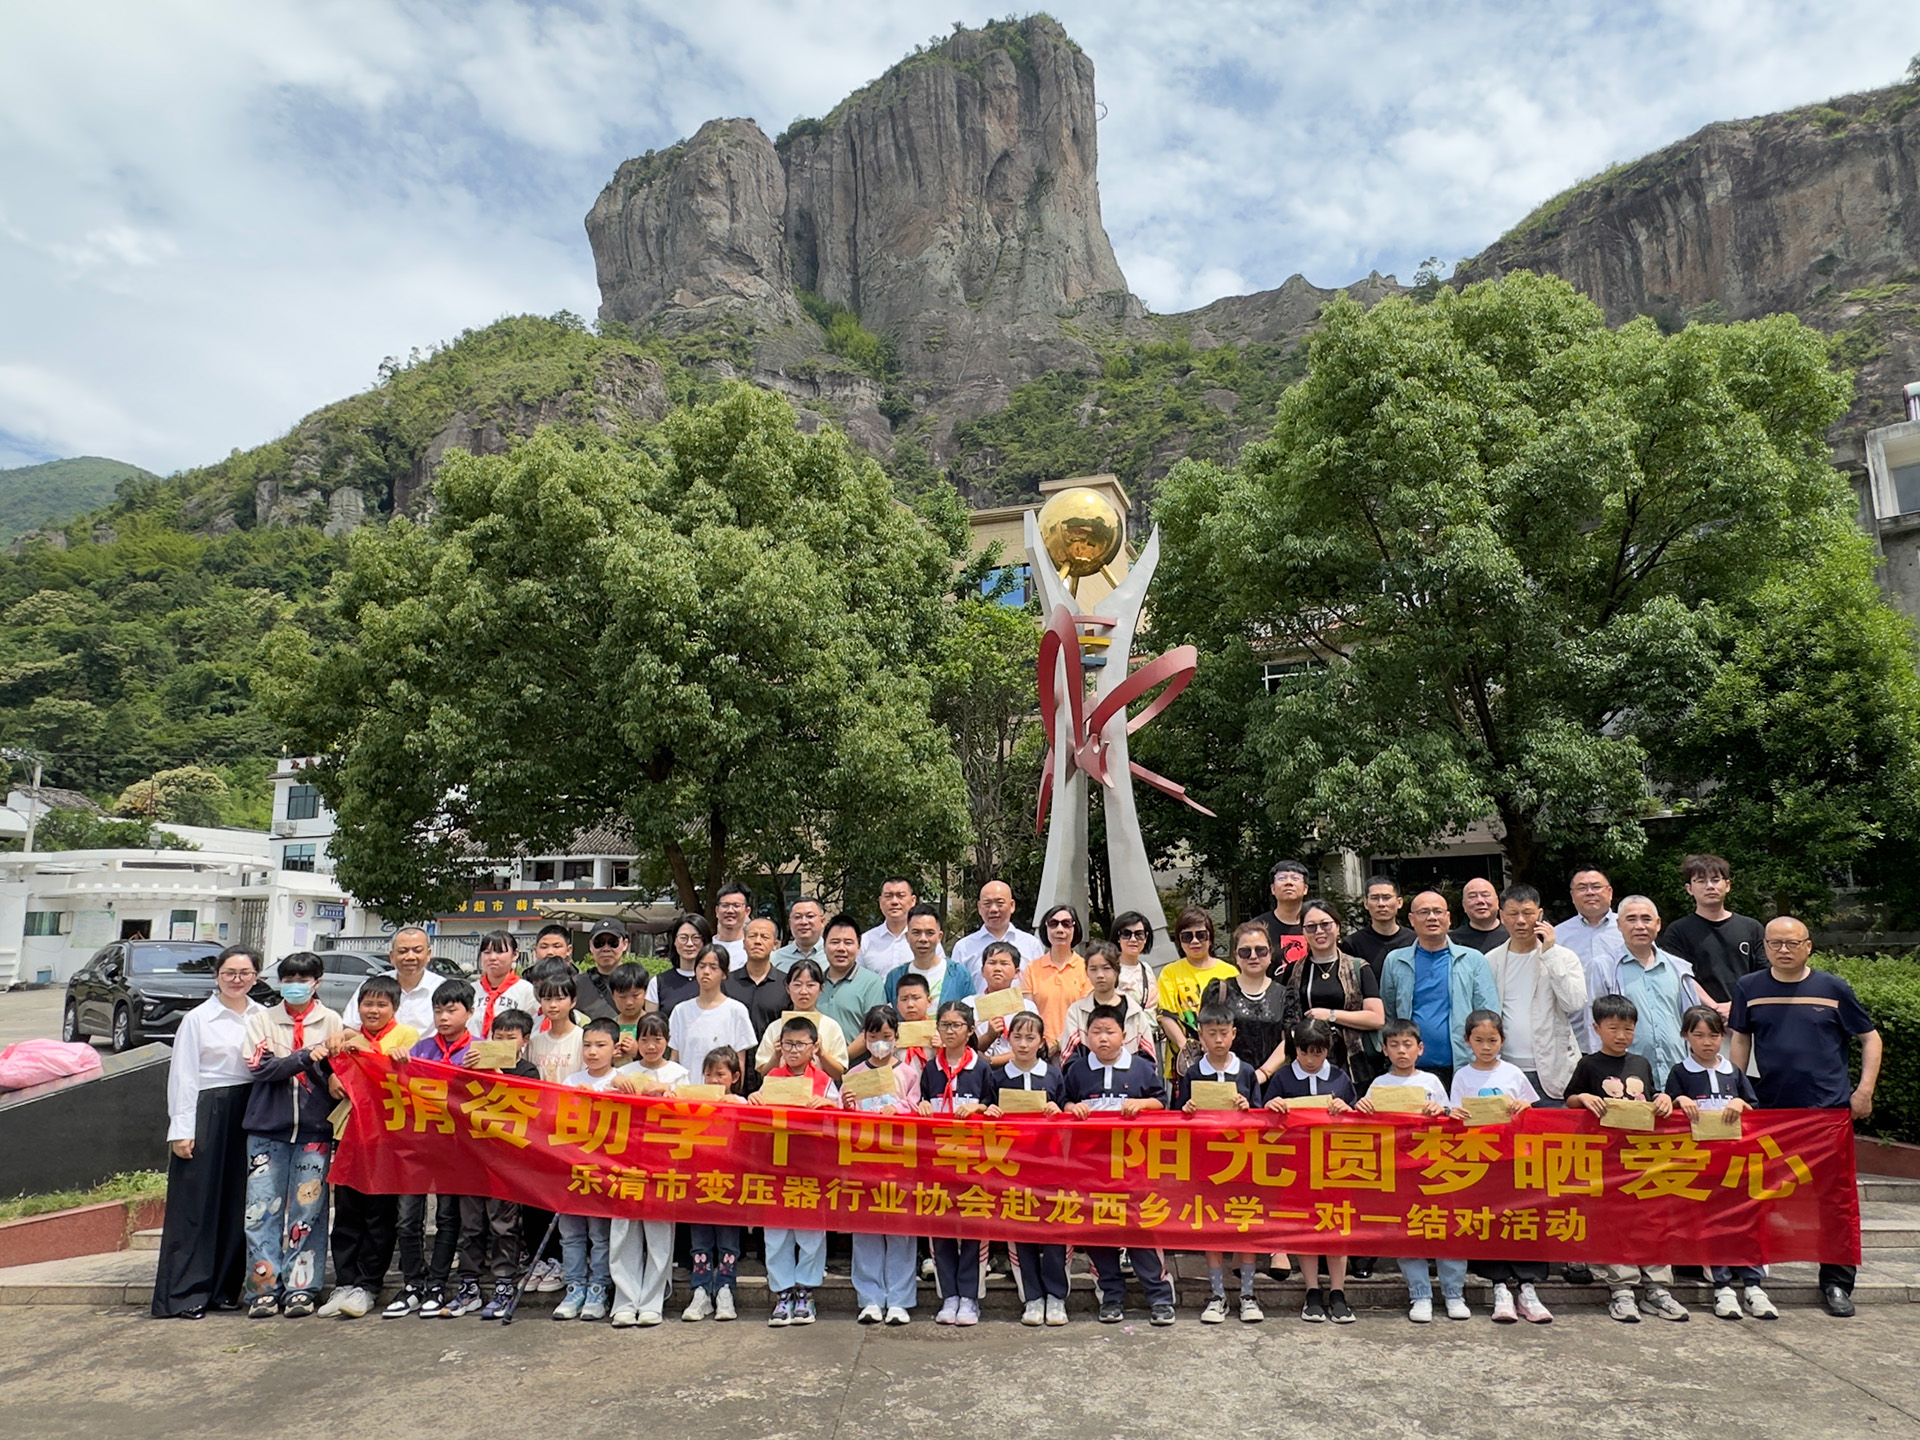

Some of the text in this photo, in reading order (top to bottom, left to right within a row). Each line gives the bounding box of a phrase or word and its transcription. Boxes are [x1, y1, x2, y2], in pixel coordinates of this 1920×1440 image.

[381, 1073, 1814, 1202] 捐资助学十四载 阳光圆梦晒爱心
[567, 1164, 1587, 1243] 乐清市变压器行业协会赴龙西乡小学一对一结对活动
